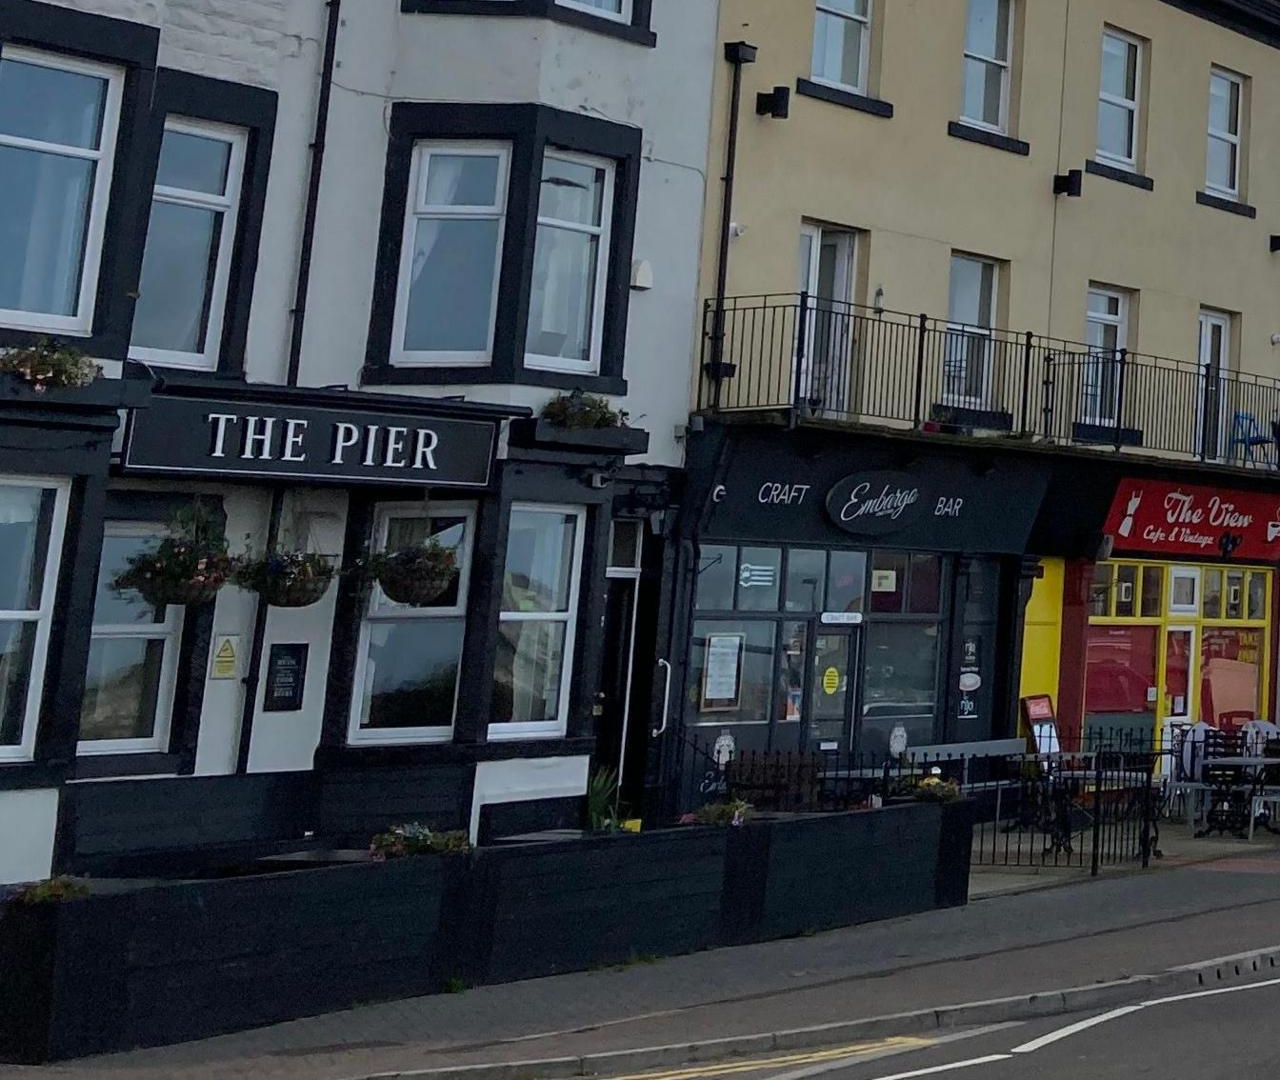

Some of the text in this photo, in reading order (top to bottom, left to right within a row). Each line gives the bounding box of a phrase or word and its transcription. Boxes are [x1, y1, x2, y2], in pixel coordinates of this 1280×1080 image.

[208, 413, 438, 470] THE PIER
[758, 482, 811, 505] CRAFT
[934, 496, 963, 517] BAR
[1164, 490, 1254, 528] The View
[1143, 524, 1215, 548] Cafe & Vintage
